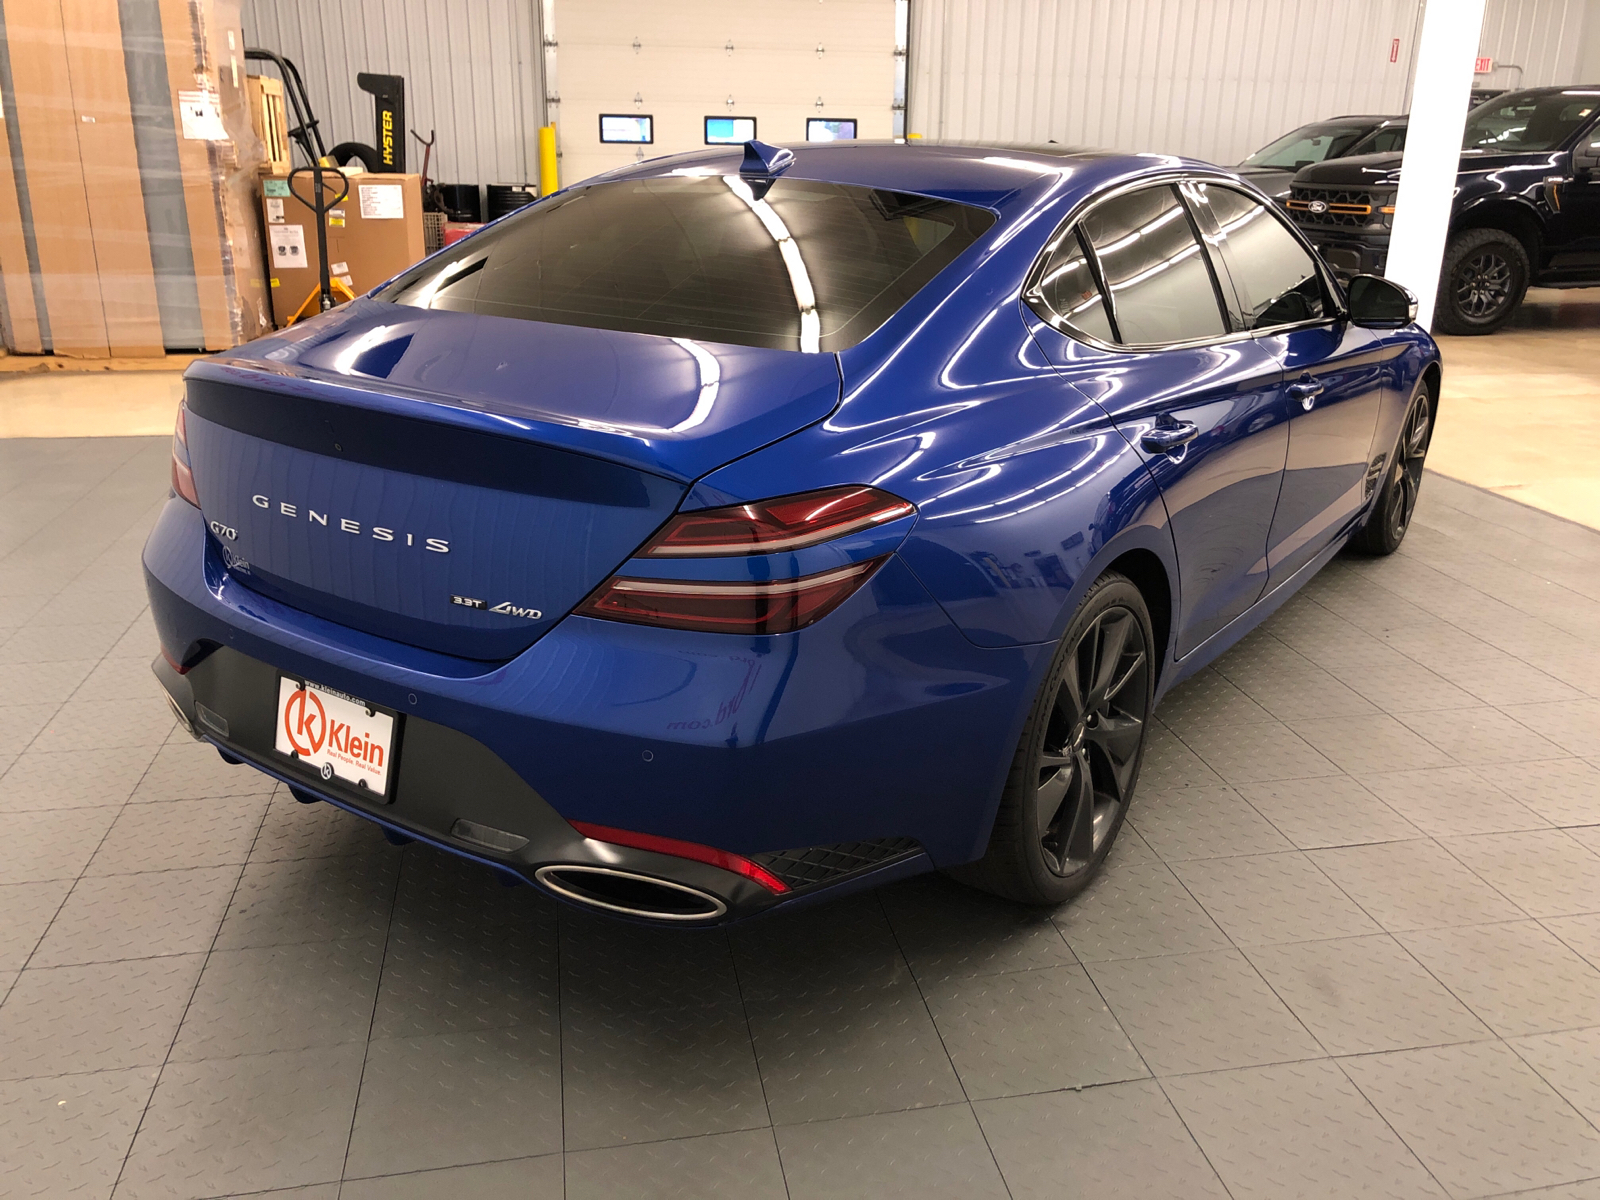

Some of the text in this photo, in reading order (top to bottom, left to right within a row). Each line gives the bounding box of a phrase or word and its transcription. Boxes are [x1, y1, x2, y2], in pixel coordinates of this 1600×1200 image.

[1475, 58, 1491, 71] EXIT
[382, 110, 394, 165] HYSTER
[210, 520, 238, 541] G70
[252, 494, 450, 553] GENESIS
[453, 596, 543, 620] 3.3T 4WD
[304, 680, 366, 707] www.kleinauto.com
[328, 719, 384, 767] Klein
